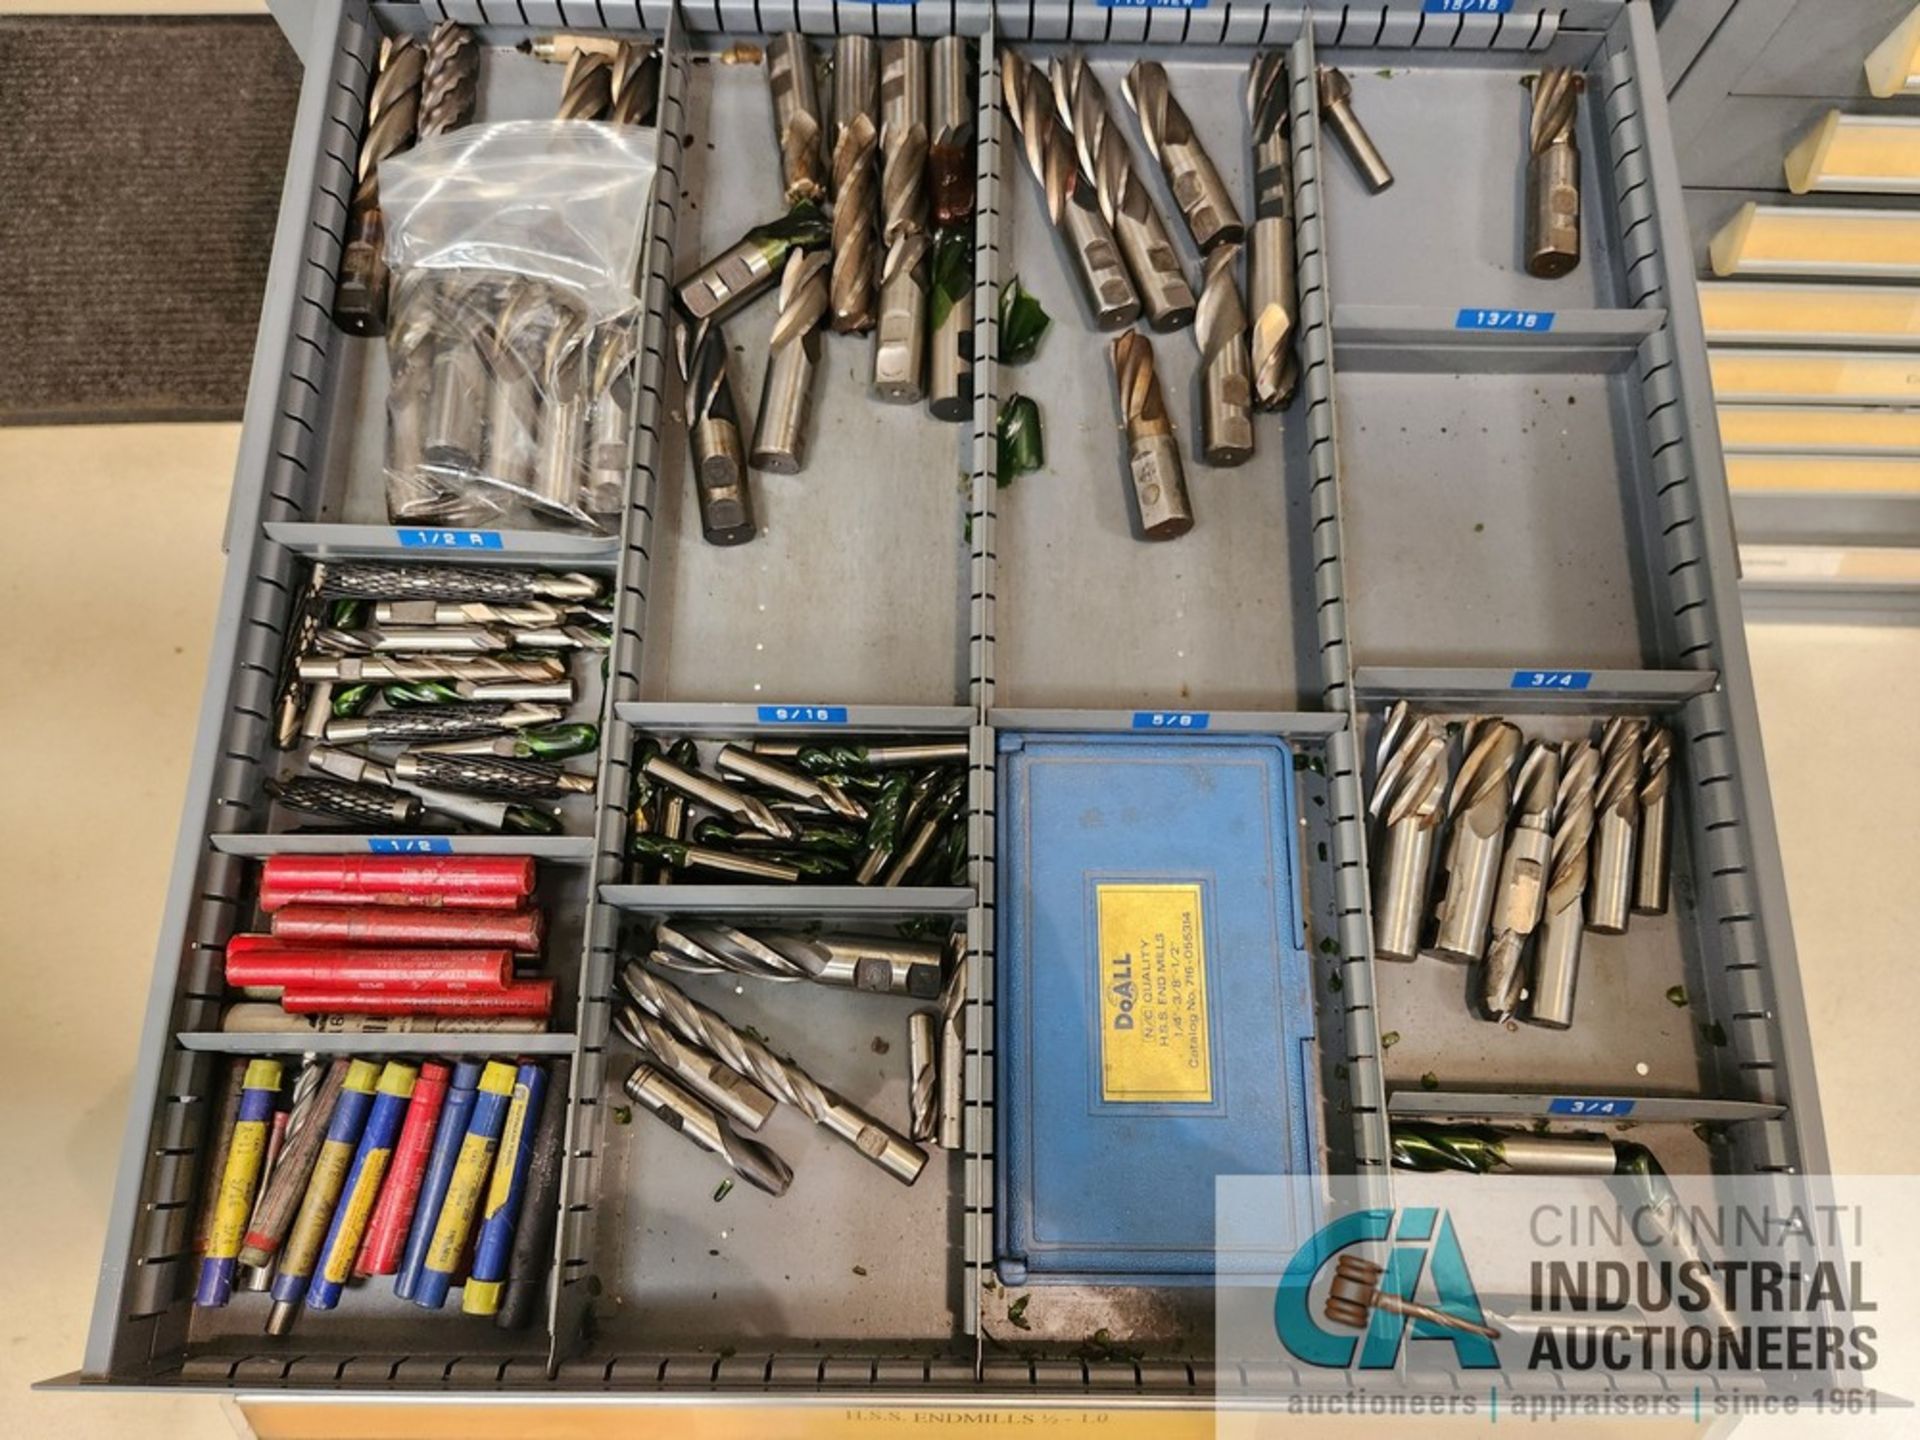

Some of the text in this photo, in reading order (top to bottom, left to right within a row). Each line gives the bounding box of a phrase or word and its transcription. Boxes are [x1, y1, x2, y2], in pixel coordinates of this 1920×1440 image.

[1477, 311, 1538, 328] 13/16
[418, 530, 456, 545] 1/2
[1531, 672, 1572, 687] 3/4
[1152, 714, 1192, 727] 5/8
[391, 840, 433, 852] 1/2
[1154, 932, 1166, 975] MILLS
[1112, 952, 1134, 1031] DoALL
[1140, 938, 1154, 1039] N/C QUALITY
[1157, 976, 1167, 1005] END
[1187, 1015, 1199, 1069] Catalog
[1571, 1101, 1614, 1113] 3/4
[914, 1412, 1035, 1425] ENDMILLS
